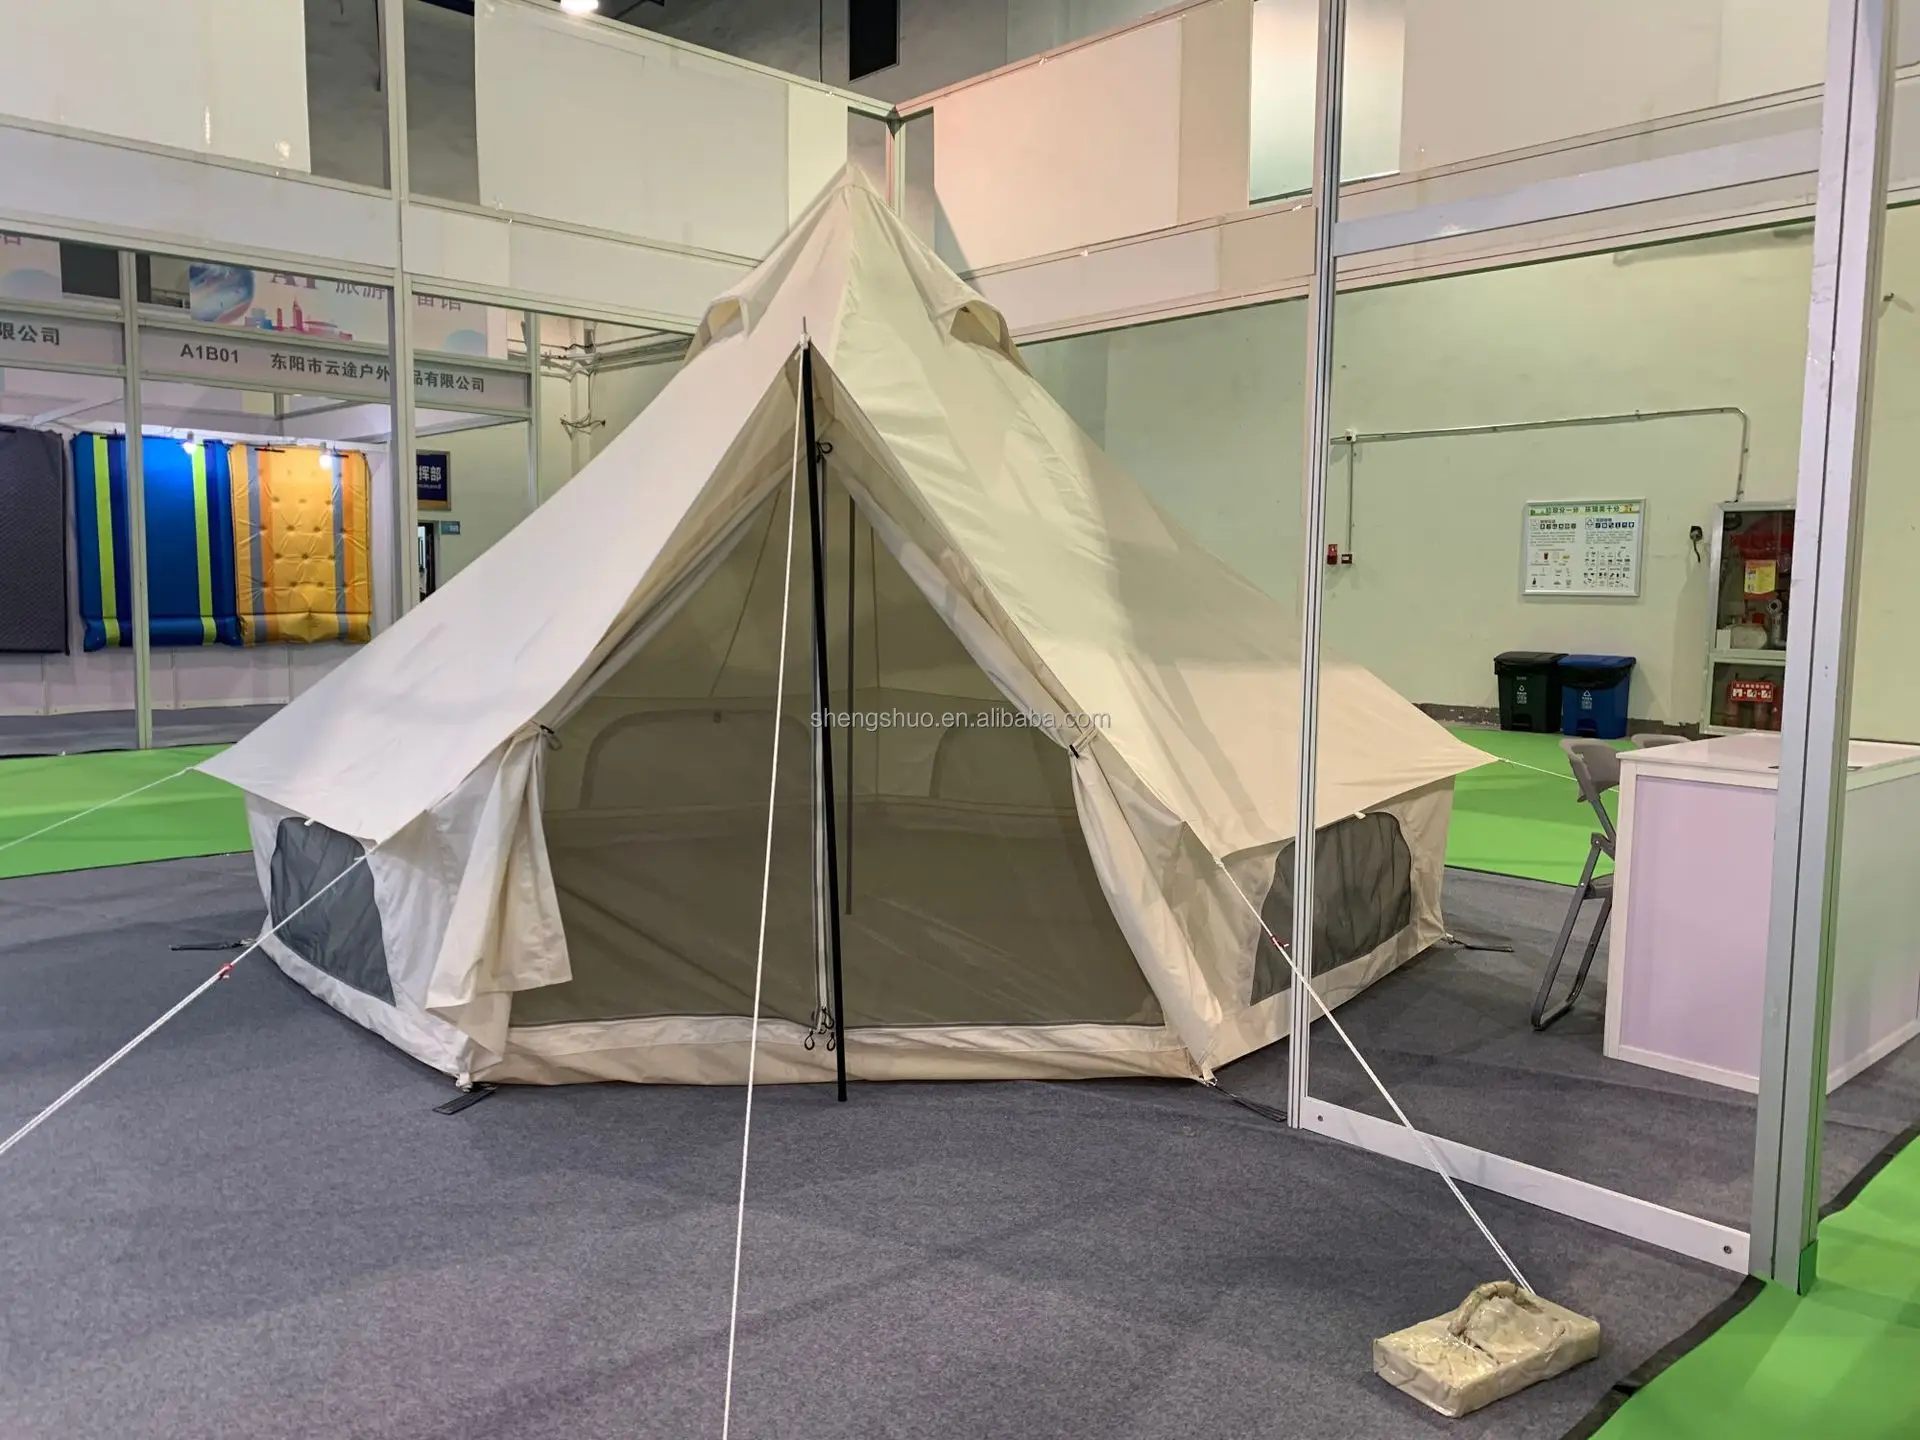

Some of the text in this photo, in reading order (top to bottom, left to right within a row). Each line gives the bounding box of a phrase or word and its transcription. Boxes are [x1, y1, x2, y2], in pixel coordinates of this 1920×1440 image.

[180, 343, 485, 393] A1B01 东阳市云途户外品有限公司
[416, 465, 442, 482] 挥部
